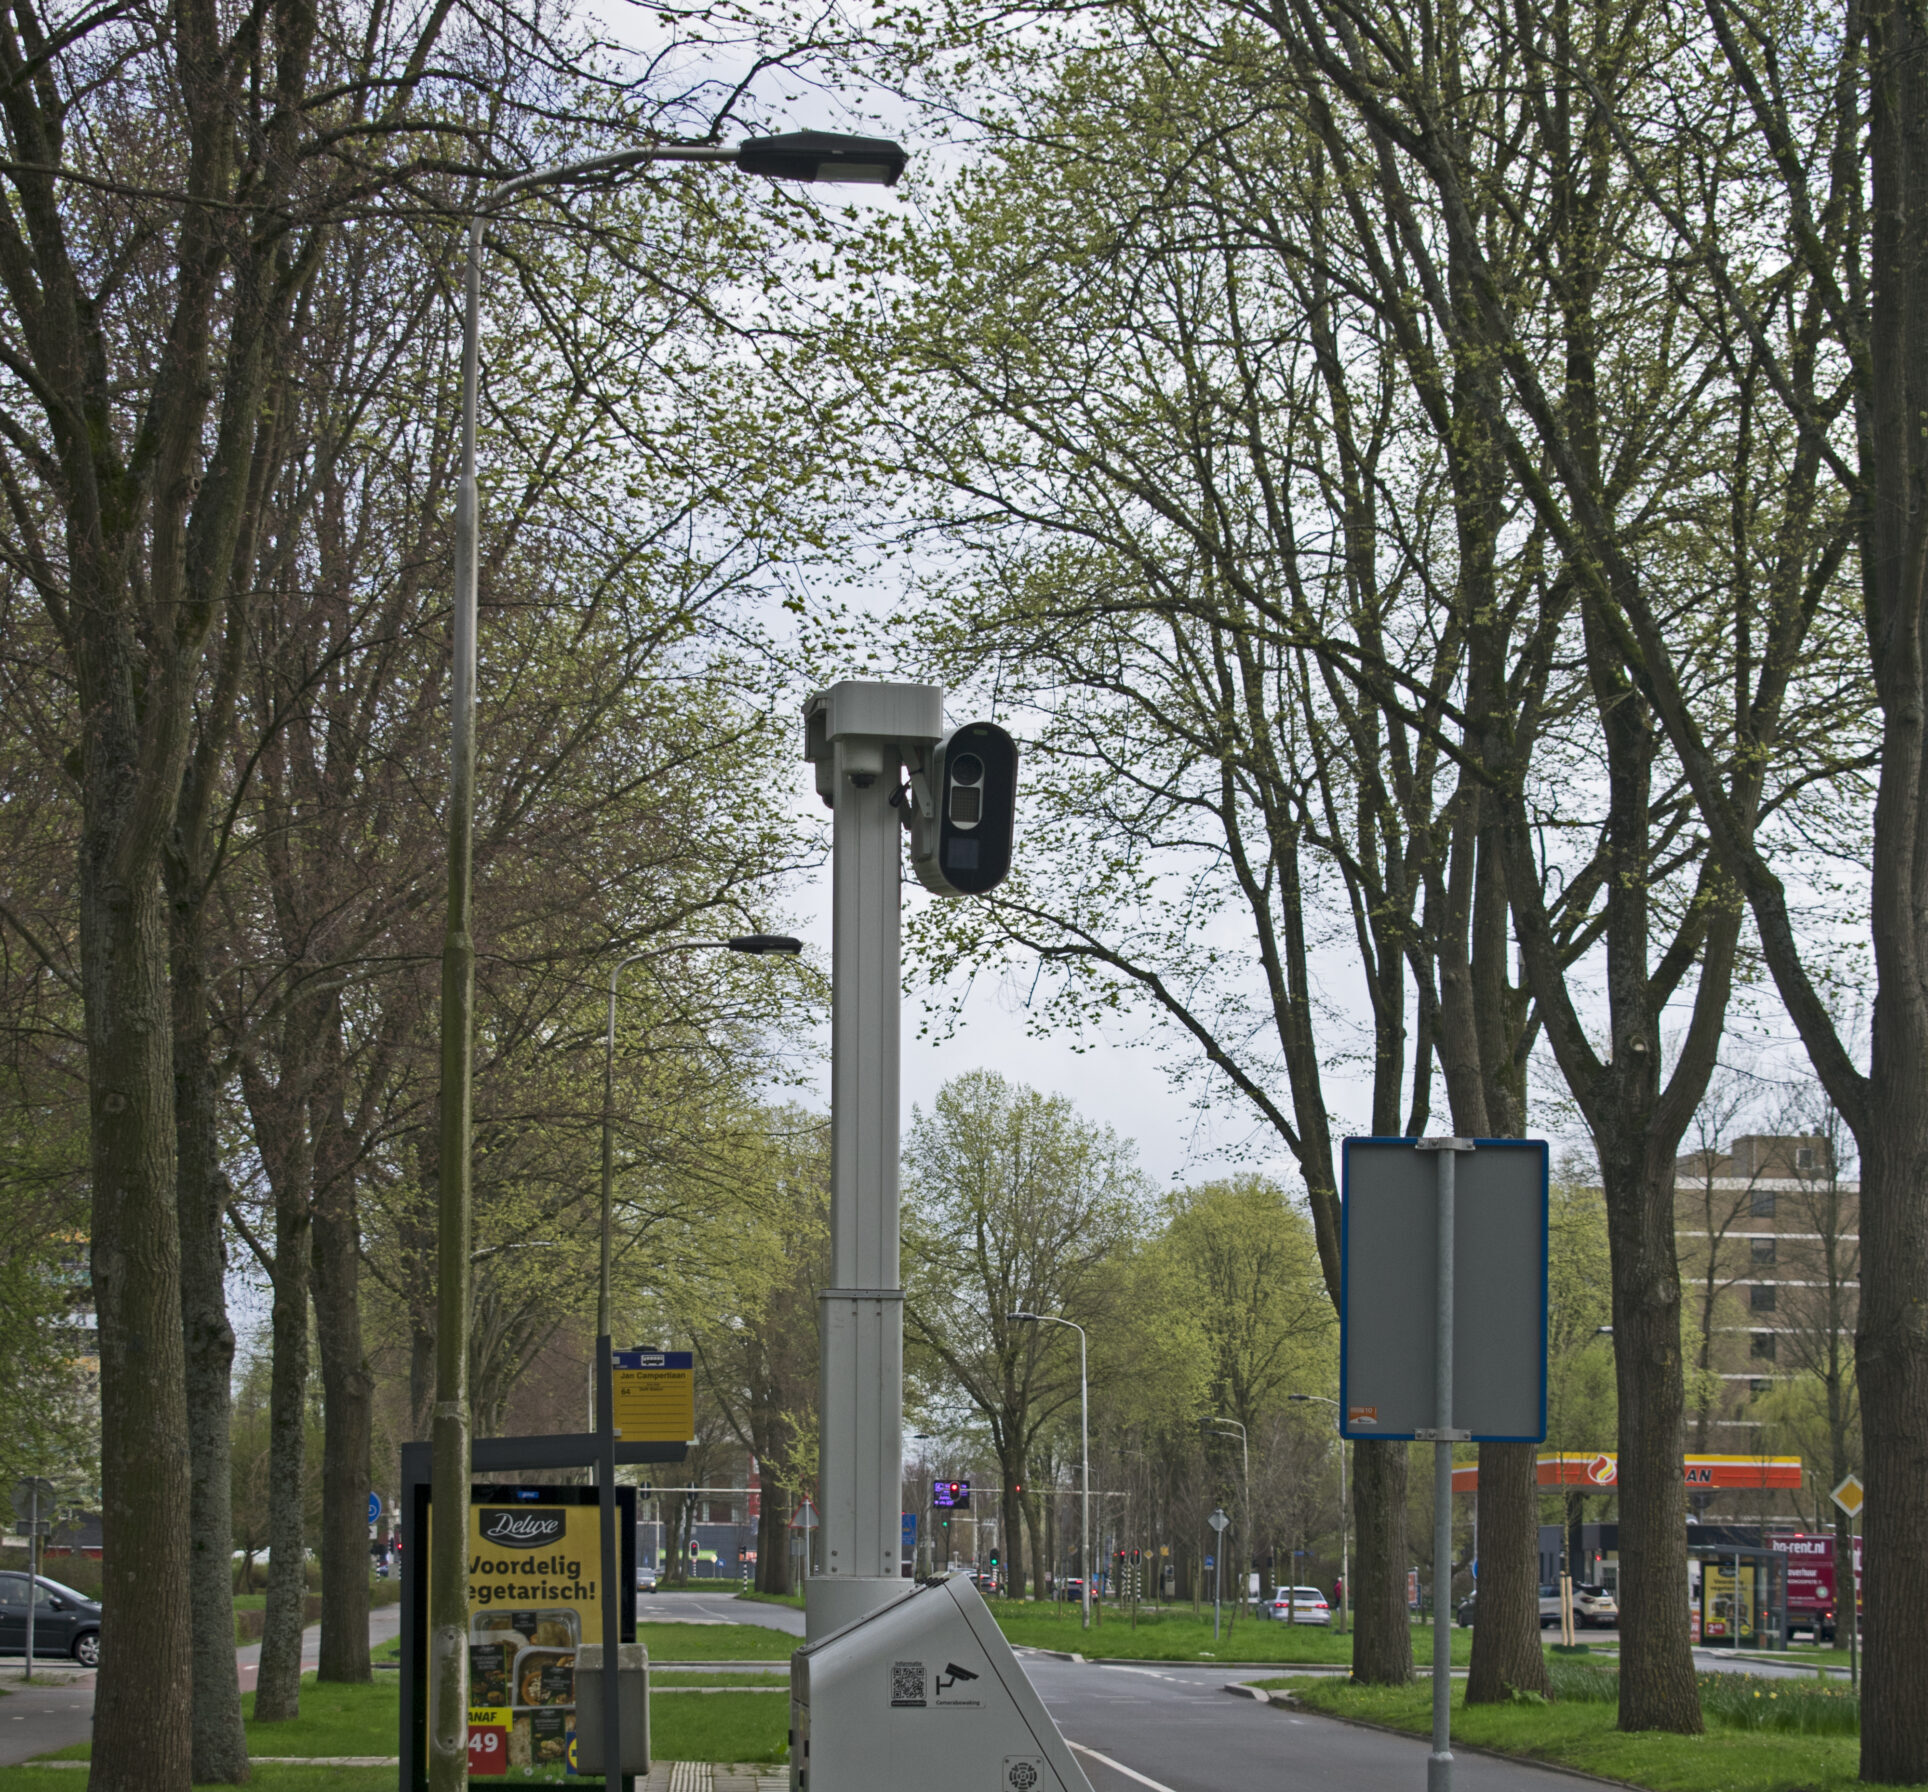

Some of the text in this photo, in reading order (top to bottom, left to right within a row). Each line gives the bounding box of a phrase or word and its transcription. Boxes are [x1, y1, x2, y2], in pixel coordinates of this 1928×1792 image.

[1685, 1468, 1712, 1482] AN
[486, 1512, 559, 1539] Deluxe
[469, 1580, 596, 1604] egetarisch!
[468, 1711, 498, 1722] ANAF
